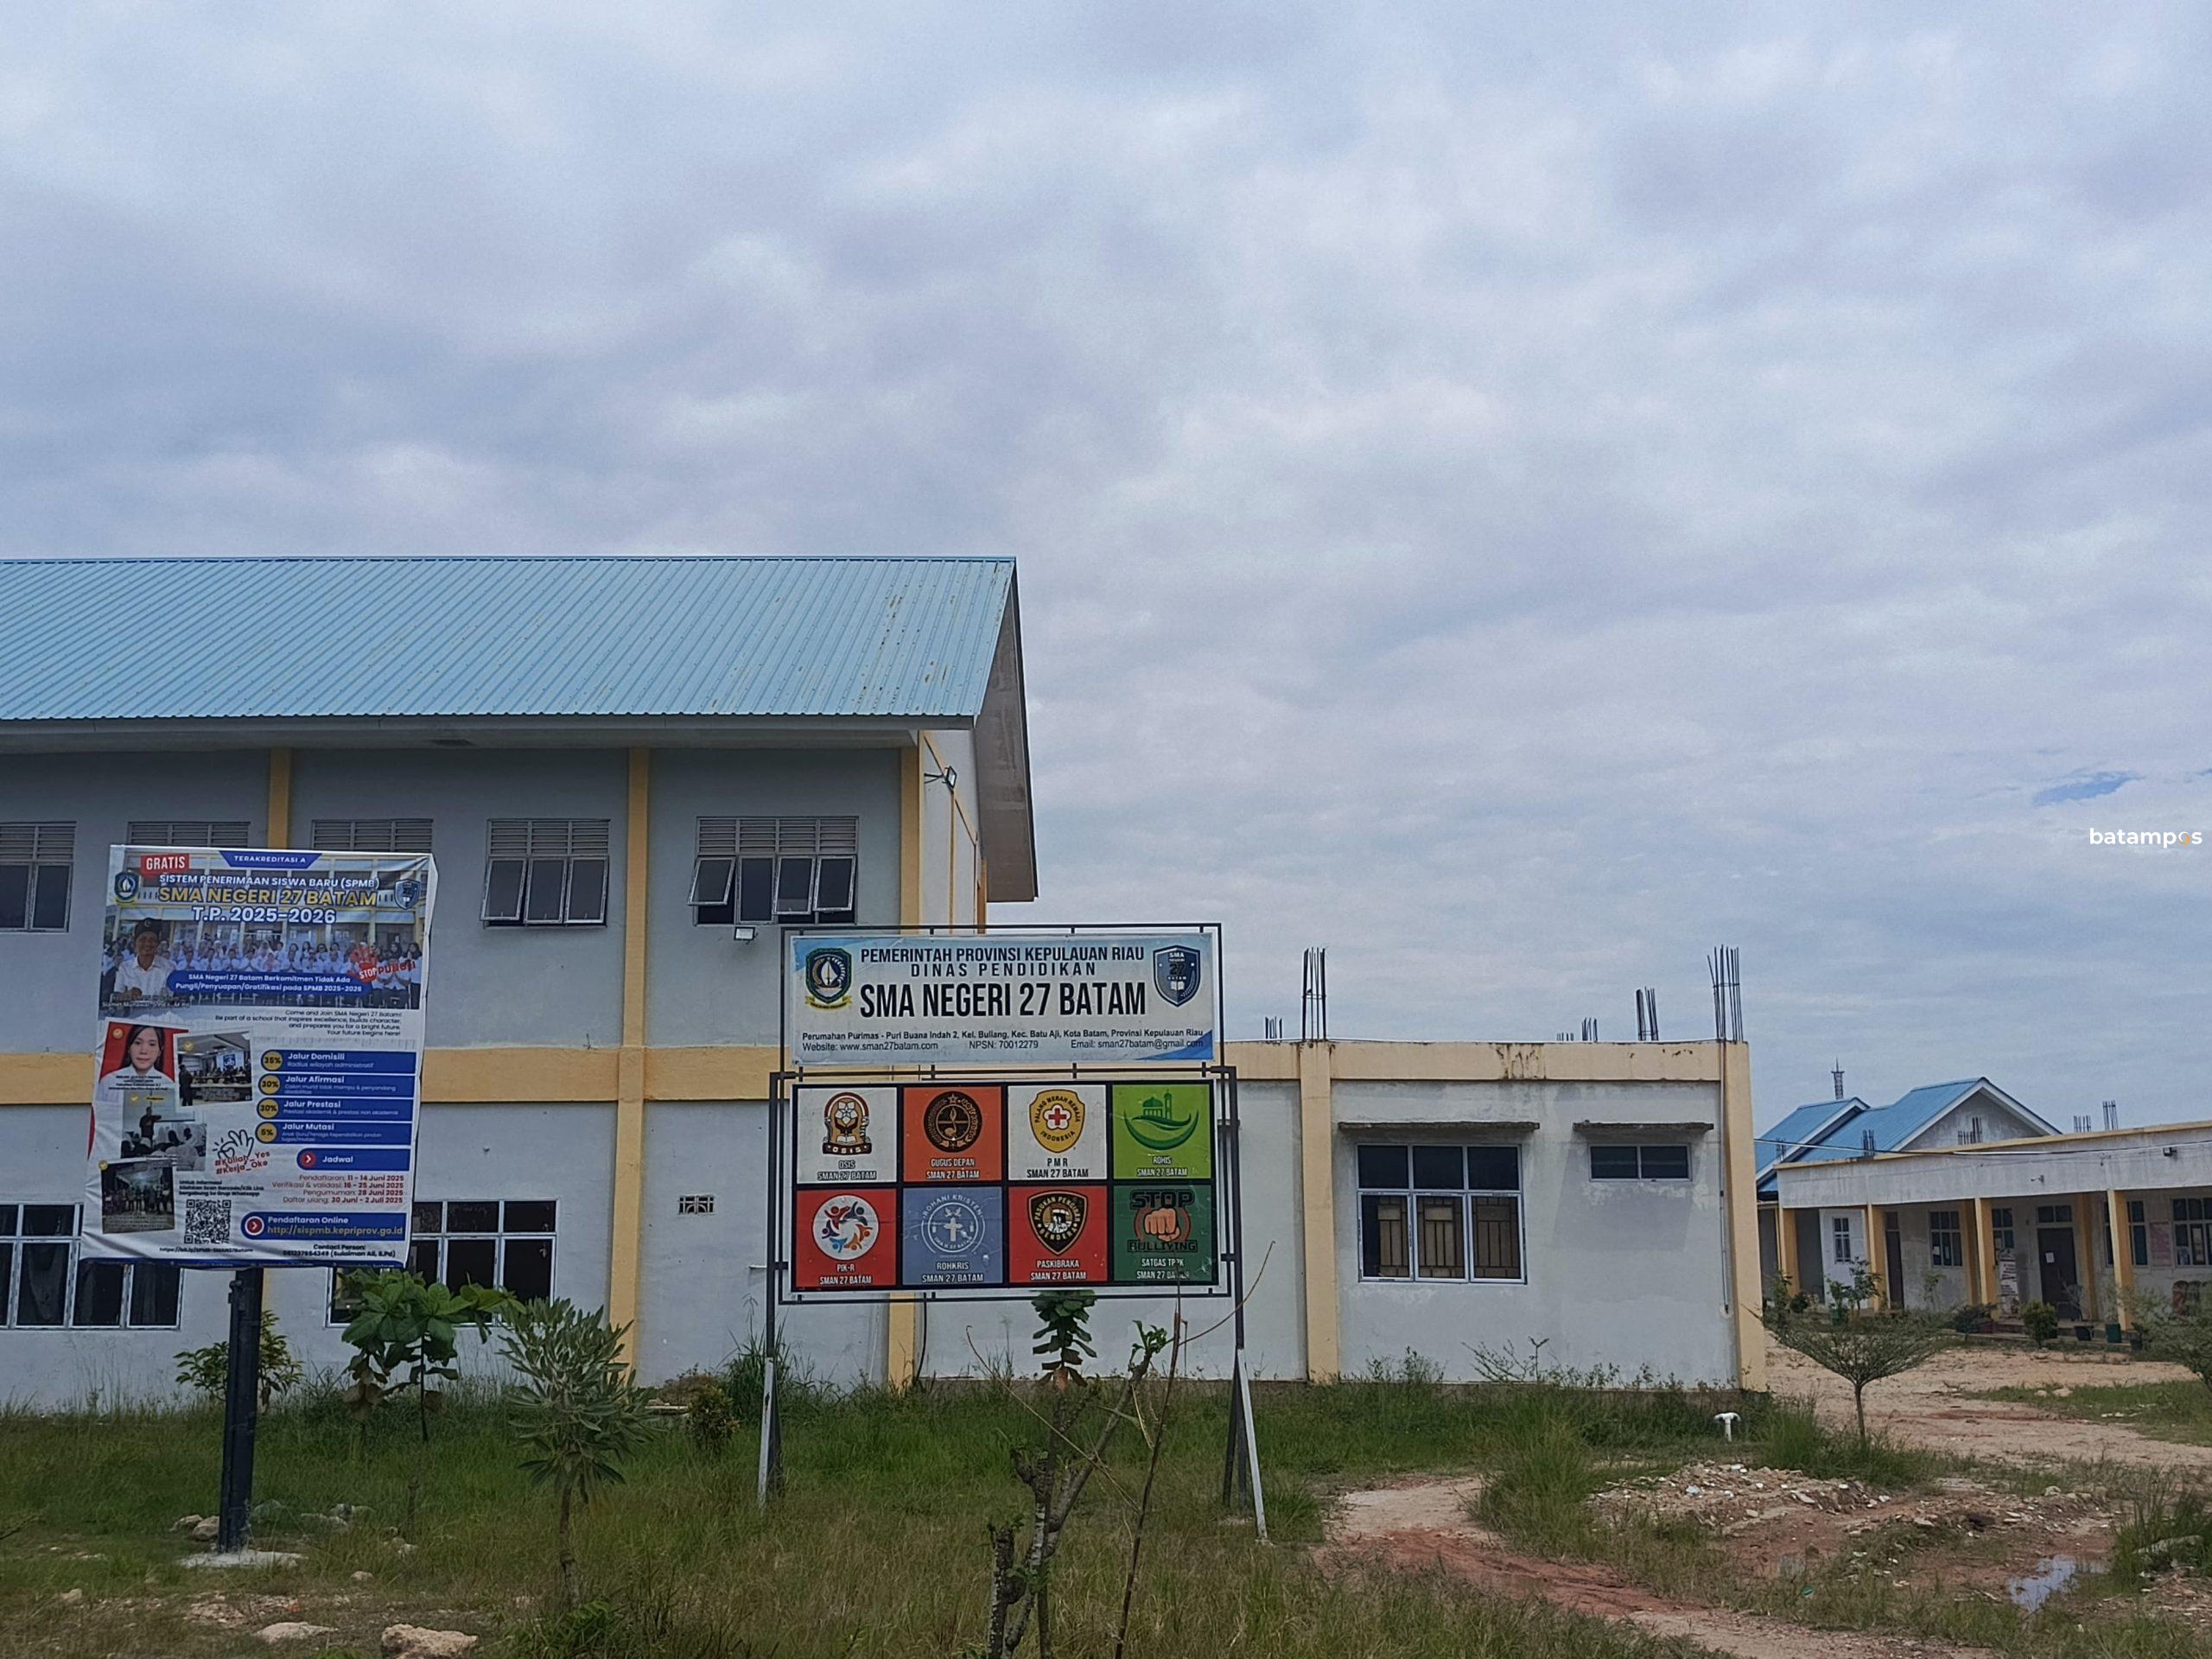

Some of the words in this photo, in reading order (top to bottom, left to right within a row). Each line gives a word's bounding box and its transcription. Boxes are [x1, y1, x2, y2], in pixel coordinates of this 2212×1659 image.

[146, 855, 186, 870] GRATIS
[159, 874, 197, 883] SISTEM
[200, 875, 270, 885] PENERIMAAN
[271, 877, 307, 887] SISWA
[308, 878, 338, 887] BARU
[340, 878, 380, 889] (SPMB)
[159, 887, 203, 902] SMA
[207, 887, 276, 903] NEGERI
[279, 889, 303, 905] 27
[305, 890, 378, 906] BATAM
[192, 906, 226, 922] T.P.
[230, 907, 336, 923] 2025-2026
[861, 948, 950, 963] PEMERINTAH
[956, 947, 1020, 962] PROVINSI
[1025, 946, 1108, 961] KEPULAUAN
[1111, 946, 1144, 961] RIAU
[359, 967, 378, 979] STOP
[911, 963, 968, 977] DINAS
[979, 962, 1096, 976] PENDIDIKAN
[1169, 963, 1185, 975] 27
[860, 983, 915, 1018] SMA
[923, 982, 1011, 1017] NEGERI
[1019, 982, 1051, 1016] 27
[1059, 982, 1146, 1015] BATAM
[952, 1031, 960, 1039] 2,
[1083, 1029, 1109, 1038] Batam,
[1144, 1028, 1184, 1038] Kepulauan
[802, 1042, 837, 1051] Website:
[839, 1041, 938, 1051] www.sman27batam.com
[969, 1040, 996, 1049] NPSN:
[999, 1039, 1039, 1049] 70012279
[1071, 1039, 1096, 1048] Email:
[1097, 1039, 1204, 1050] sman27batam@gmail.com
[1040, 1130, 1076, 1141] INDONESIA
[838, 1160, 855, 1169] OSIS
[931, 1158, 952, 1166] GUGUS
[953, 1158, 975, 1166] DEPAN
[1153, 1156, 1172, 1165] ROHIS
[817, 1172, 839, 1180] SMAN
[840, 1171, 850, 1180] 27
[850, 1171, 877, 1180] BATAM
[926, 1171, 945, 1179] SMAN
[957, 1170, 980, 1179] BATAM
[1027, 1169, 1048, 1178] SMAN
[1050, 1169, 1060, 1178] 27
[1062, 1168, 1089, 1178] BATAM
[1166, 1167, 1188, 1176] BATAM
[922, 1194, 950, 1216] ROHANI
[952, 1194, 982, 1215] KRISTEN
[1129, 1190, 1196, 1210] STOP
[1034, 1197, 1056, 1220] PASUKAN
[267, 1225, 404, 1236] http://sispmb.kepriprov.go.id
[1039, 1228, 1077, 1240] BENDERA
[836, 1263, 855, 1272] PIK-R
[937, 1262, 969, 1270] ROHKRIS
[1037, 1260, 1079, 1268] PASKIBRAKA
[1141, 1258, 1166, 1267] SATGAS
[819, 1276, 838, 1285] SMAN
[849, 1275, 872, 1284] BATAM
[957, 1274, 983, 1282] BATAM
[1030, 1272, 1050, 1281] SMAN
[1062, 1271, 1086, 1280] BATAM
[1136, 1271, 1155, 1280] SMAN
